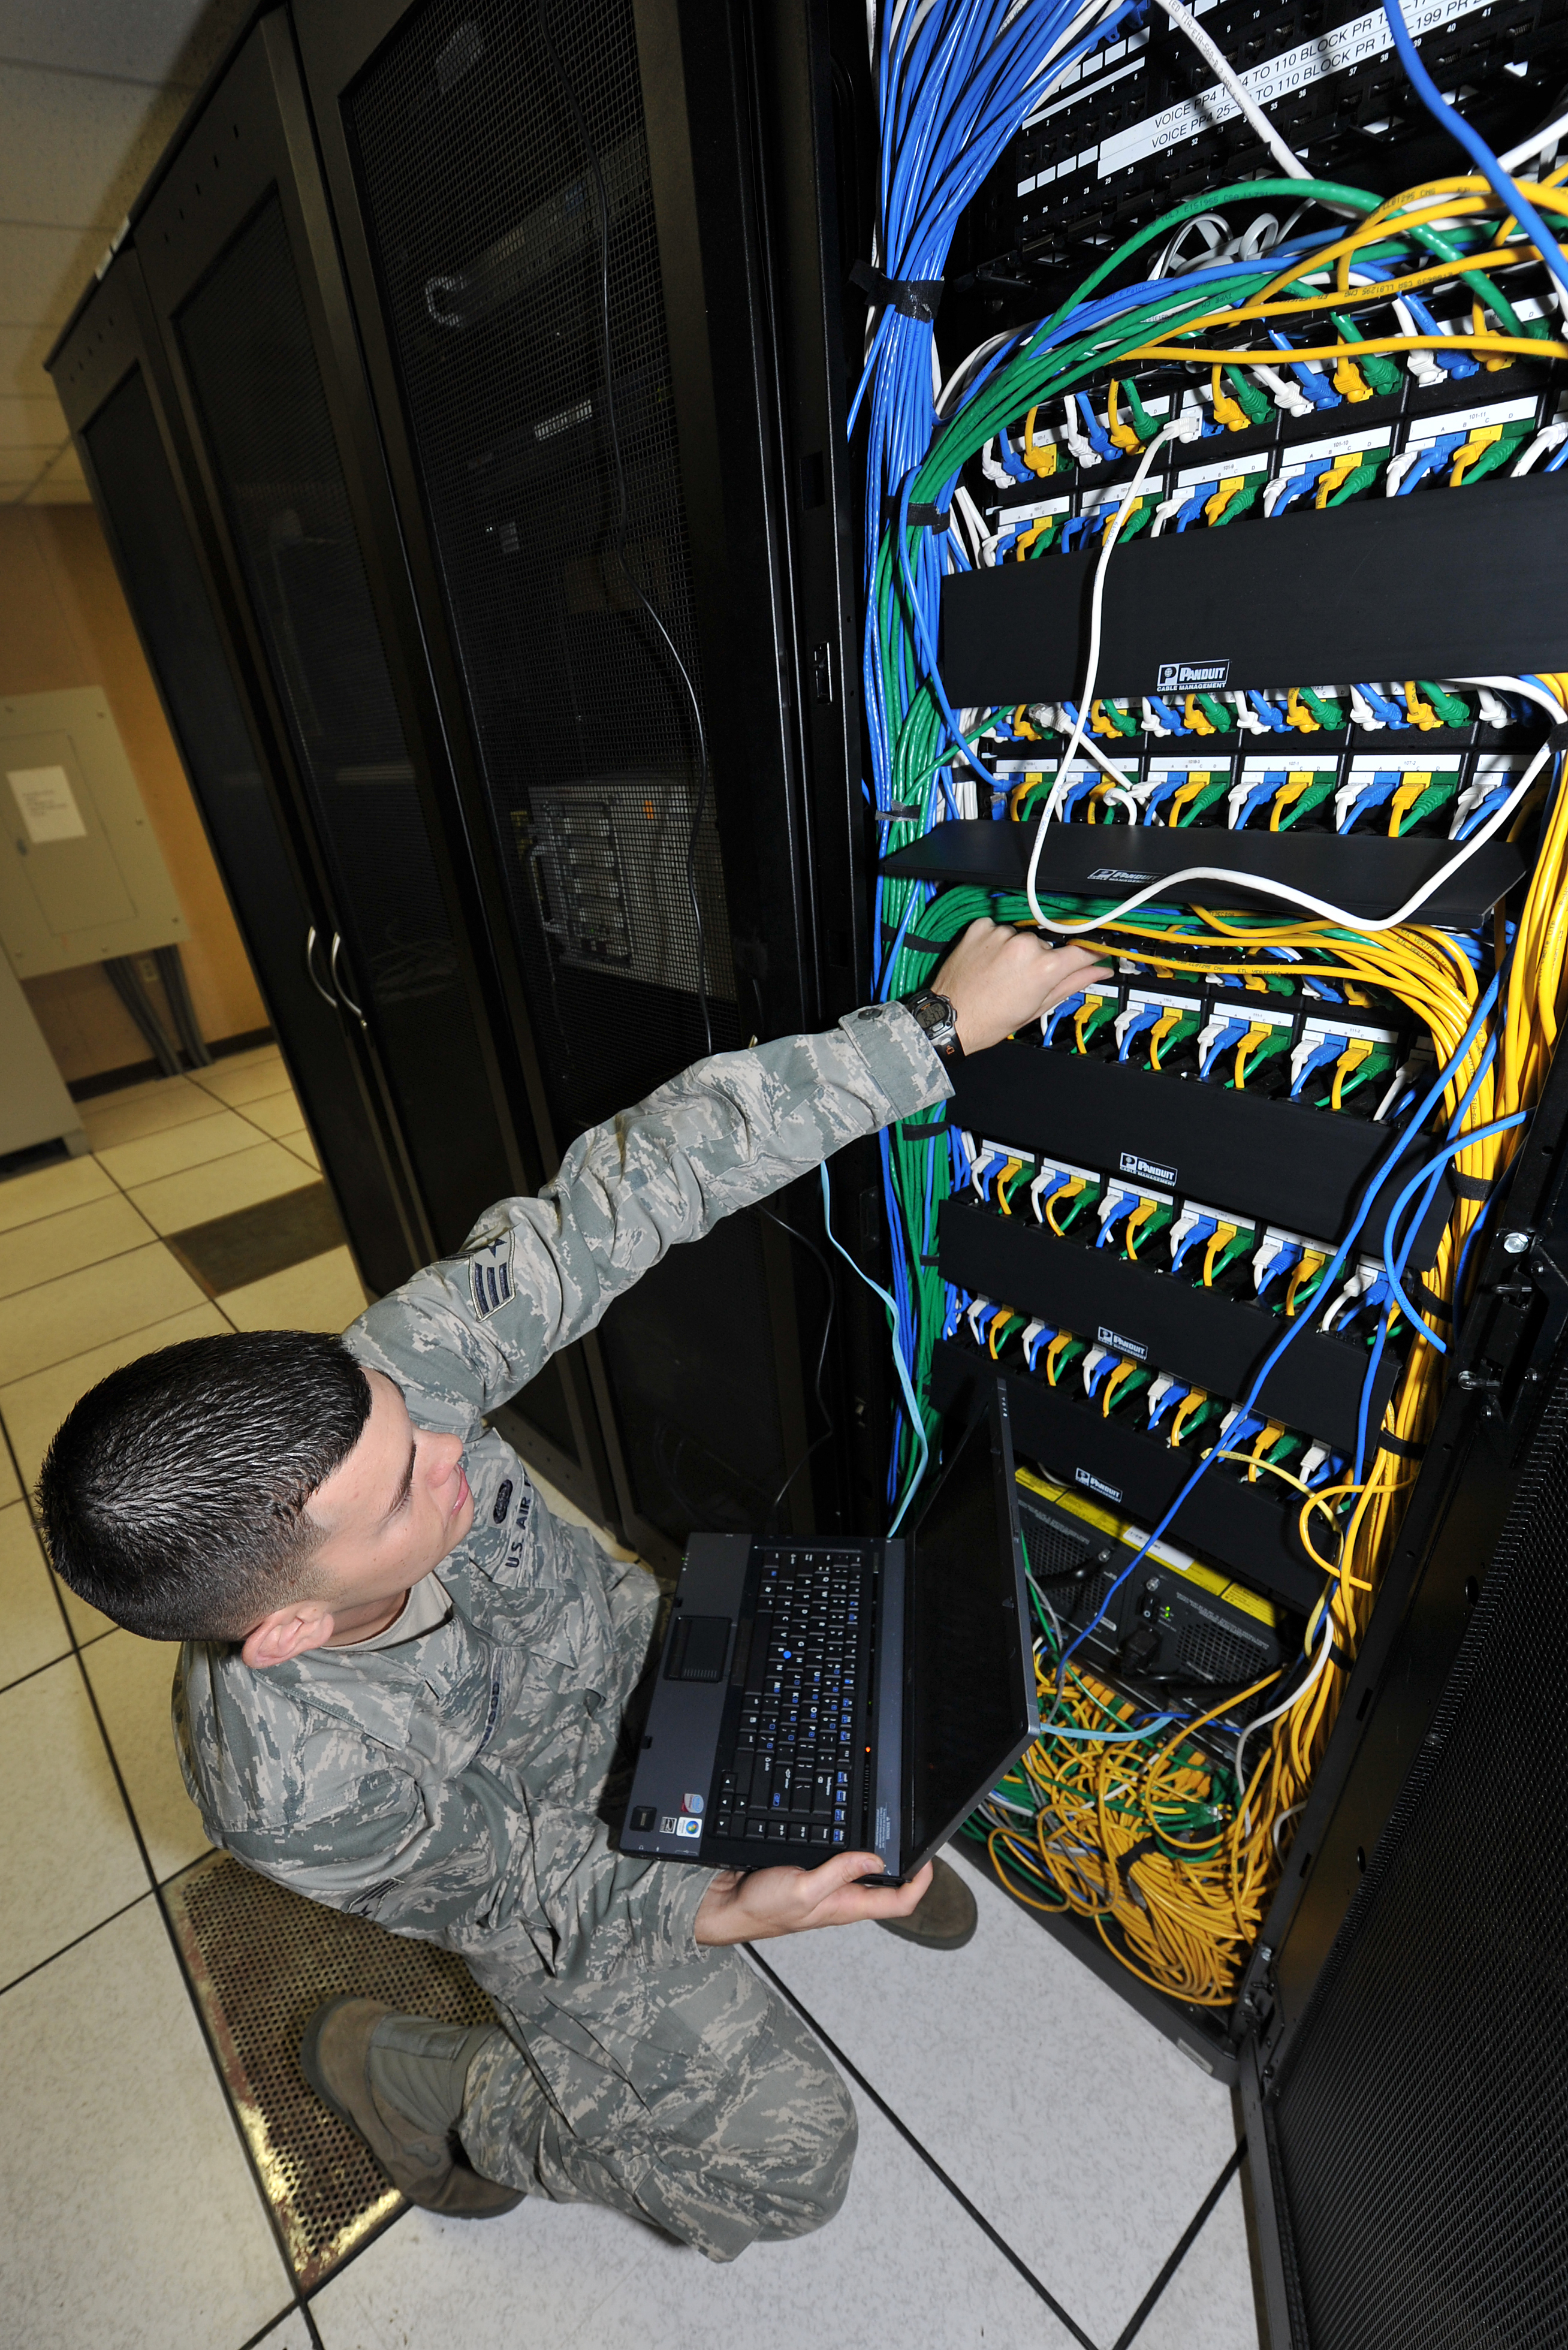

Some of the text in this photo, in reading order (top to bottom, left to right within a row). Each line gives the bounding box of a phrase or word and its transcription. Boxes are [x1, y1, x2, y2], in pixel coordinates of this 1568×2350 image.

[1253, 10, 1260, 19] 10
[1482, 7, 1491, 17] 41
[1446, 23, 1456, 32] 40
[1413, 38, 1422, 48] 39
[1380, 52, 1389, 62] 38
[1155, 17, 1373, 128] VOICE PP4 TO 110 BLOCK PR
[1349, 66, 1358, 76] 37
[1152, 124, 1187, 149] VOICE
[1191, 114, 1213, 131] PP4
[1256, 85, 1274, 101] TO
[1278, 73, 1300, 91] 110
[1304, 52, 1350, 80] BLOCK
[1356, 38, 1375, 58] PR
[1270, 101, 1278, 111] 35
[1191, 137, 1198, 146] 32
[1167, 149, 1173, 157] 31
[1362, 283, 1394, 295] LL81295
[1469, 411, 1487, 420] 101-11
[1179, 667, 1226, 681] PANDUIT
[1179, 681, 1226, 690] MANAGEMENT
[1112, 871, 1160, 880] PANDUIT
[1413, 936, 1440, 960] VERIFIED
[1138, 1160, 1175, 1180] PANDUIT
[1137, 1171, 1175, 1187] MANAGEMENT
[1113, 1335, 1145, 1355] PANDUIT
[1090, 1477, 1120, 1498] PANDUIT
[505, 1538, 524, 1568] U.S.
[515, 1496, 531, 1530] AIR
